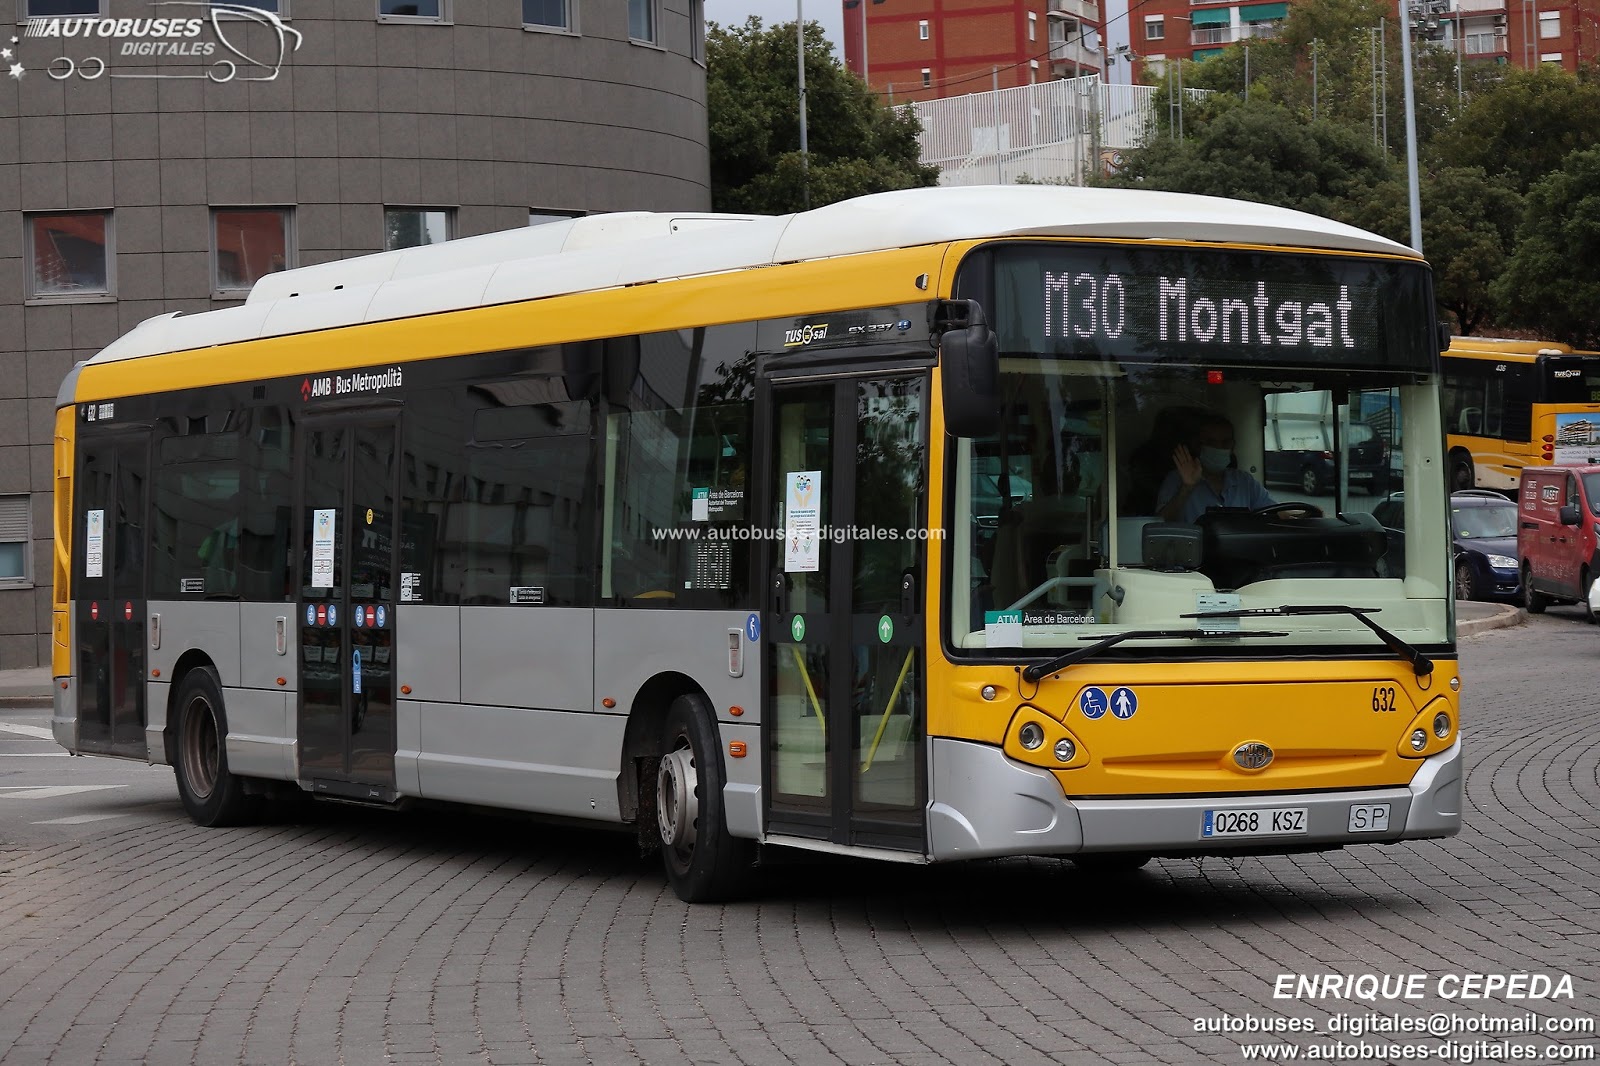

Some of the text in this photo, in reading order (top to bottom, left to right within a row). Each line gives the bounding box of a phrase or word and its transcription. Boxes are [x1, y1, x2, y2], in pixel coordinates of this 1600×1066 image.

[1045, 271, 1354, 348] M30 Montgat
[311, 366, 402, 397] AMB Bus Metropolità
[997, 612, 1095, 624] ATM Àrea de Barcelona
[1373, 688, 1396, 712] 632
[1216, 812, 1259, 832] 0268
[1272, 811, 1304, 831] KSZ
